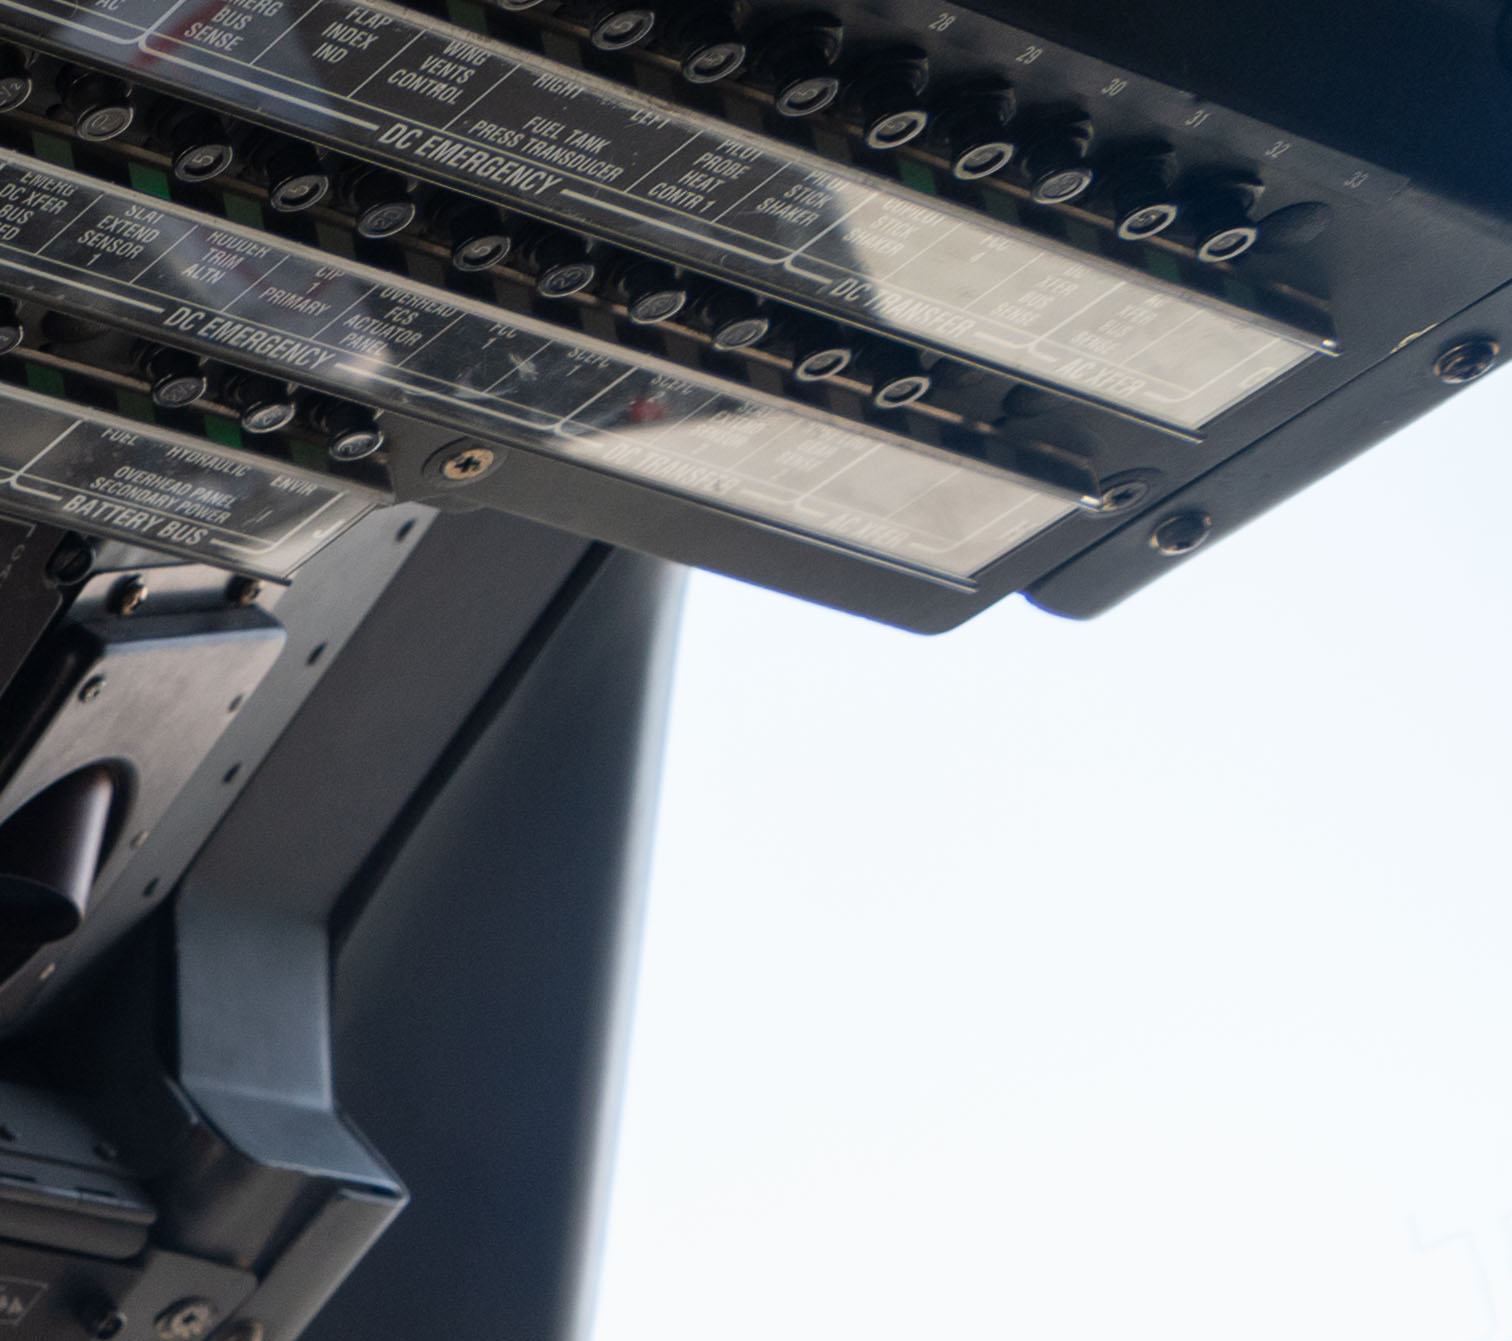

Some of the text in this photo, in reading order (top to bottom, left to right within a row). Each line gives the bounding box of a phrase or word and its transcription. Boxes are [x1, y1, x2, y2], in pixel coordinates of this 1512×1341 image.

[929, 12, 956, 32] 28
[418, 56, 473, 83] VENTS
[1015, 45, 1042, 65] 29
[387, 69, 462, 104] CONTROL
[468, 120, 622, 182] PRESS TRANSDUCER
[524, 116, 610, 153] FUEL TANK
[378, 123, 563, 196] DC EMERGENCY
[77, 228, 143, 261] SENSOR
[95, 214, 163, 246] EXTEND
[164, 306, 332, 370] DC EMERGENCY
[62, 495, 212, 547] BATTERY BUS
